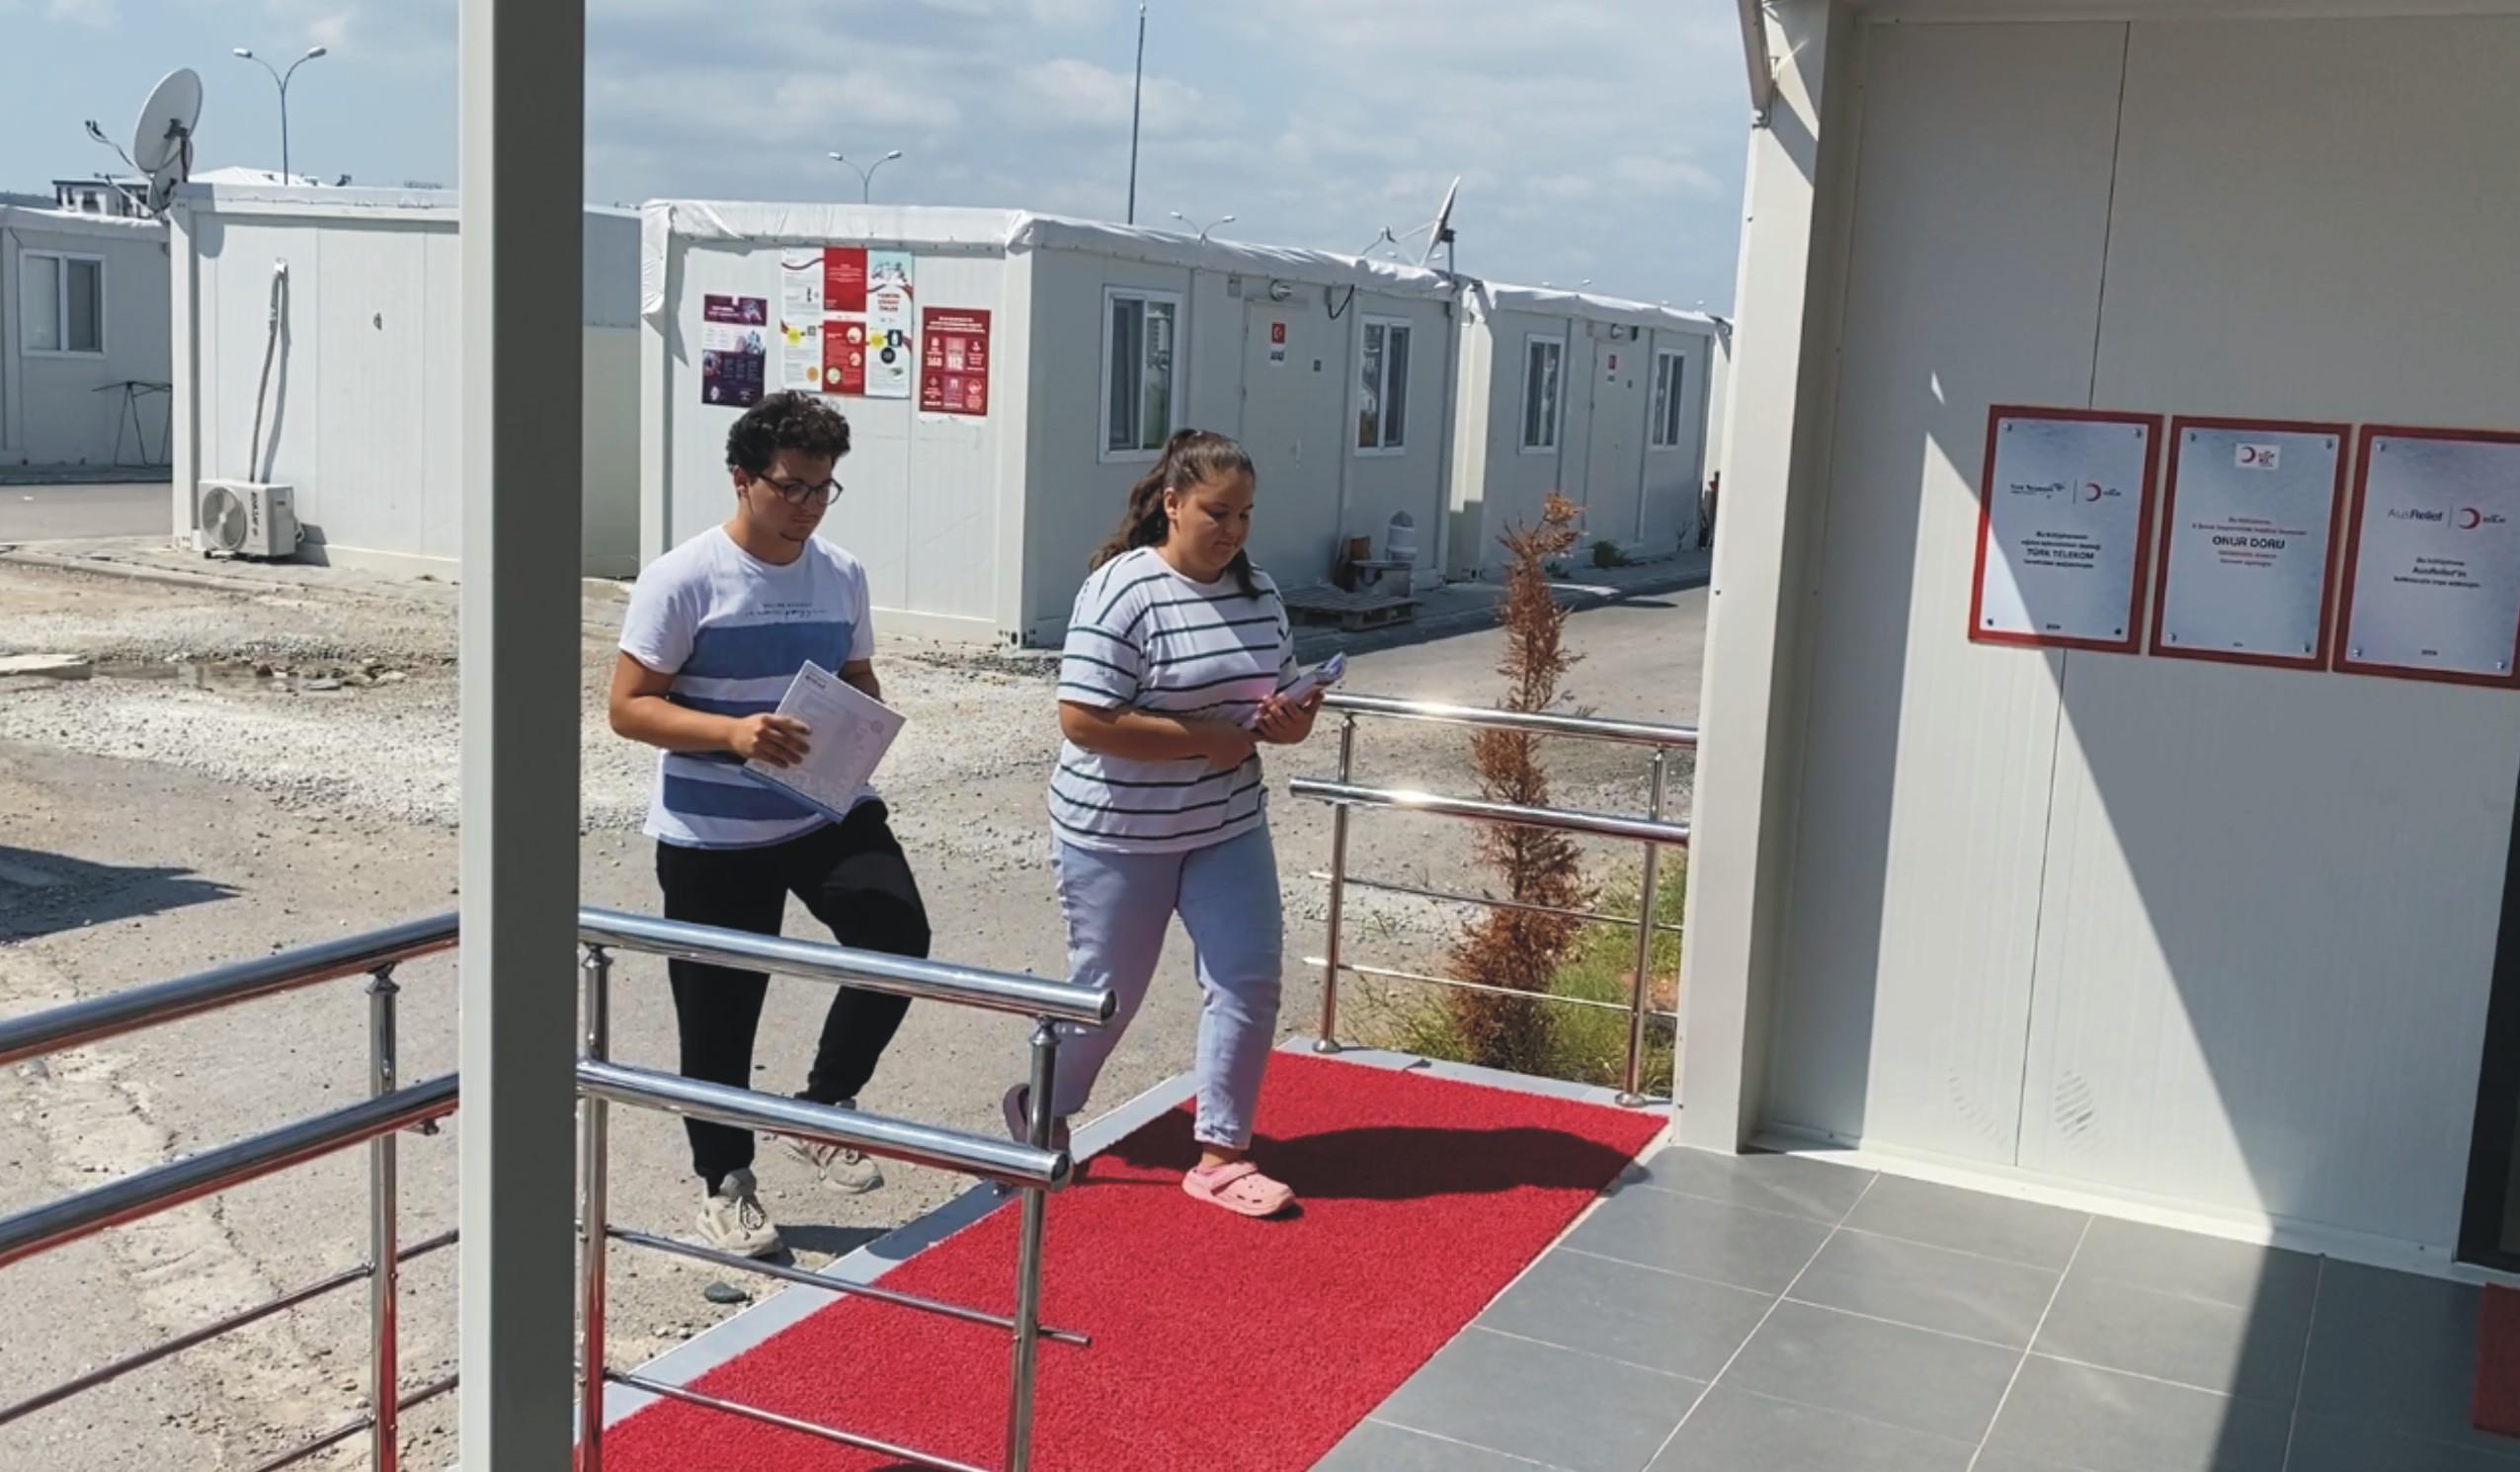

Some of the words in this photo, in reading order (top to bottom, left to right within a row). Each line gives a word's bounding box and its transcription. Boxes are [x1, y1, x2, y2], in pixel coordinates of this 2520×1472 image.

[2213, 535, 2247, 547] ONUR
[2250, 537, 2285, 549] DORU
[2027, 547, 2050, 557] TÜRK
[2053, 549, 2094, 559] TELEKOM
